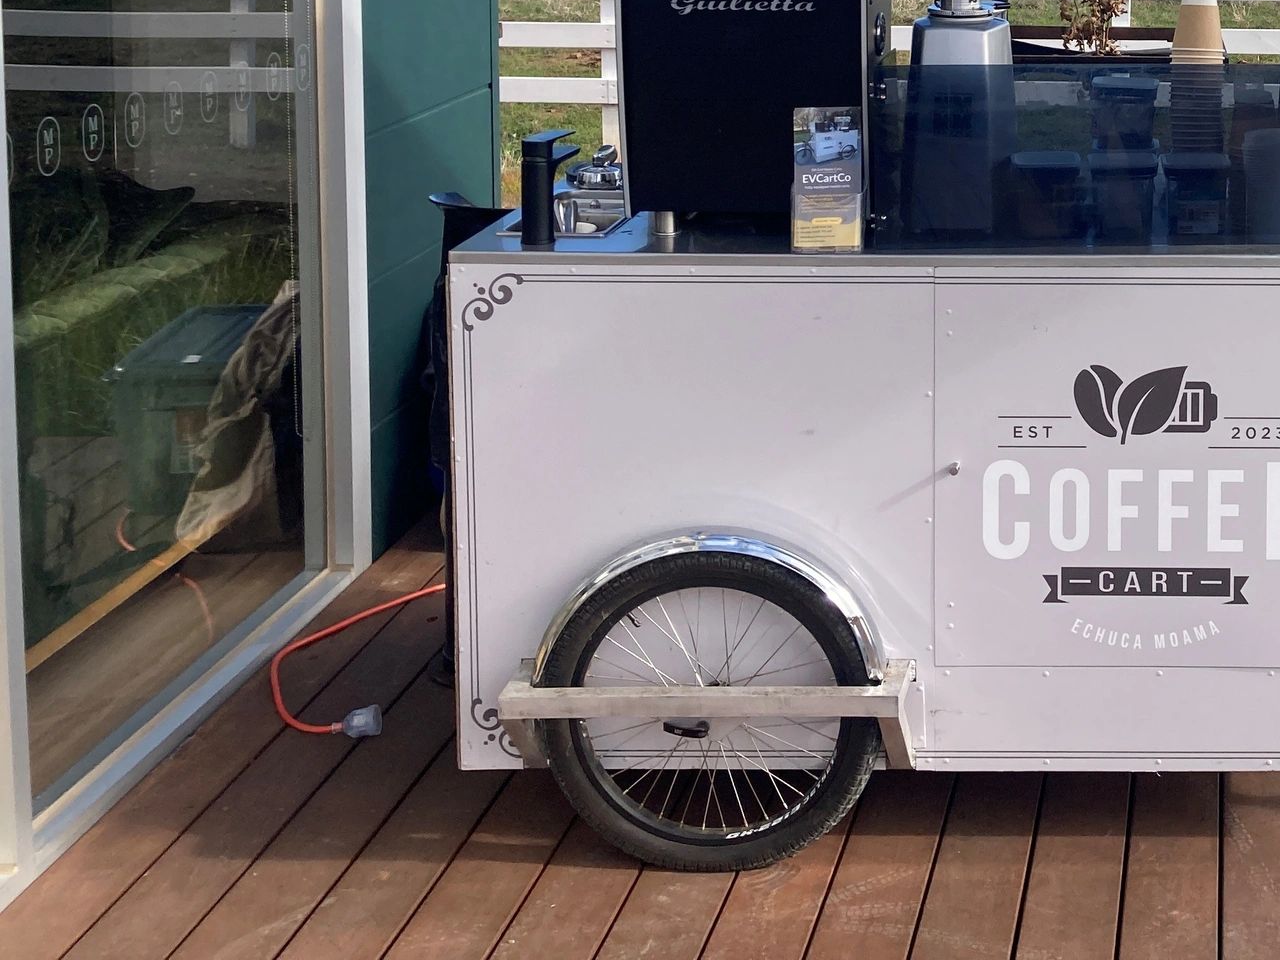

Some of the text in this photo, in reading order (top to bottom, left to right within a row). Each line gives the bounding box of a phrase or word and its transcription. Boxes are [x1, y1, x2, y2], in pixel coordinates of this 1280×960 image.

[802, 173, 851, 184] EVCartCo
[1013, 426, 1053, 439] EST
[1098, 570, 1193, 593] CART
[1071, 617, 1220, 650] ECHUCA MOAMA
